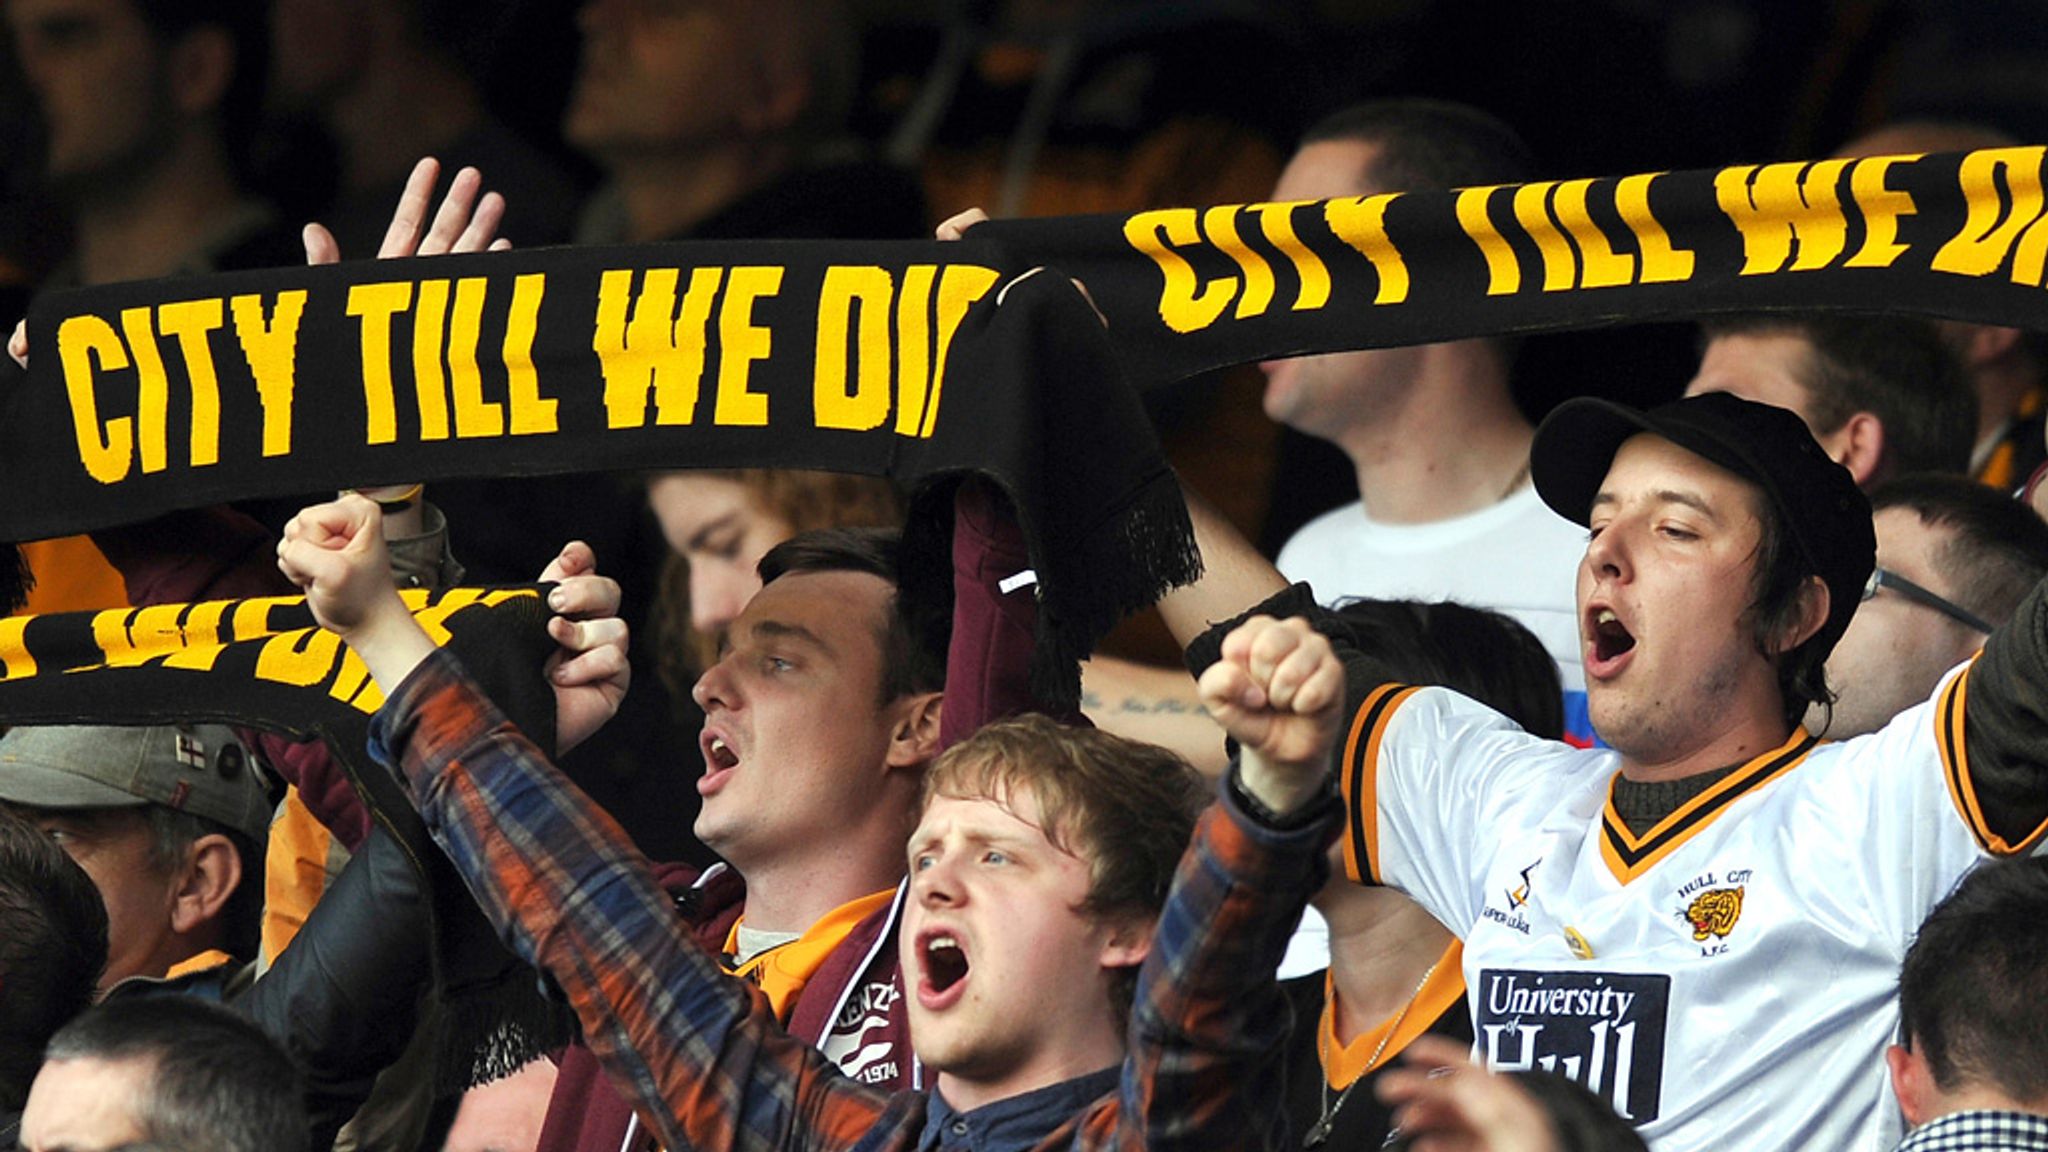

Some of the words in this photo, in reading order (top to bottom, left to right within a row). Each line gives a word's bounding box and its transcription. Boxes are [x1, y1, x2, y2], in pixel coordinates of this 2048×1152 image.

[1123, 193, 1410, 334] CITY
[1455, 172, 1696, 296] TILL
[1713, 153, 1928, 277] WE
[1930, 145, 2048, 288] DI
[57, 289, 308, 485] CITY
[345, 272, 559, 445] TILL
[592, 265, 785, 430] WE
[1677, 872, 1718, 899] HULL
[1489, 976, 1635, 1028] University
[1505, 1015, 1521, 1037] of
[863, 1062, 899, 1083] 1974
